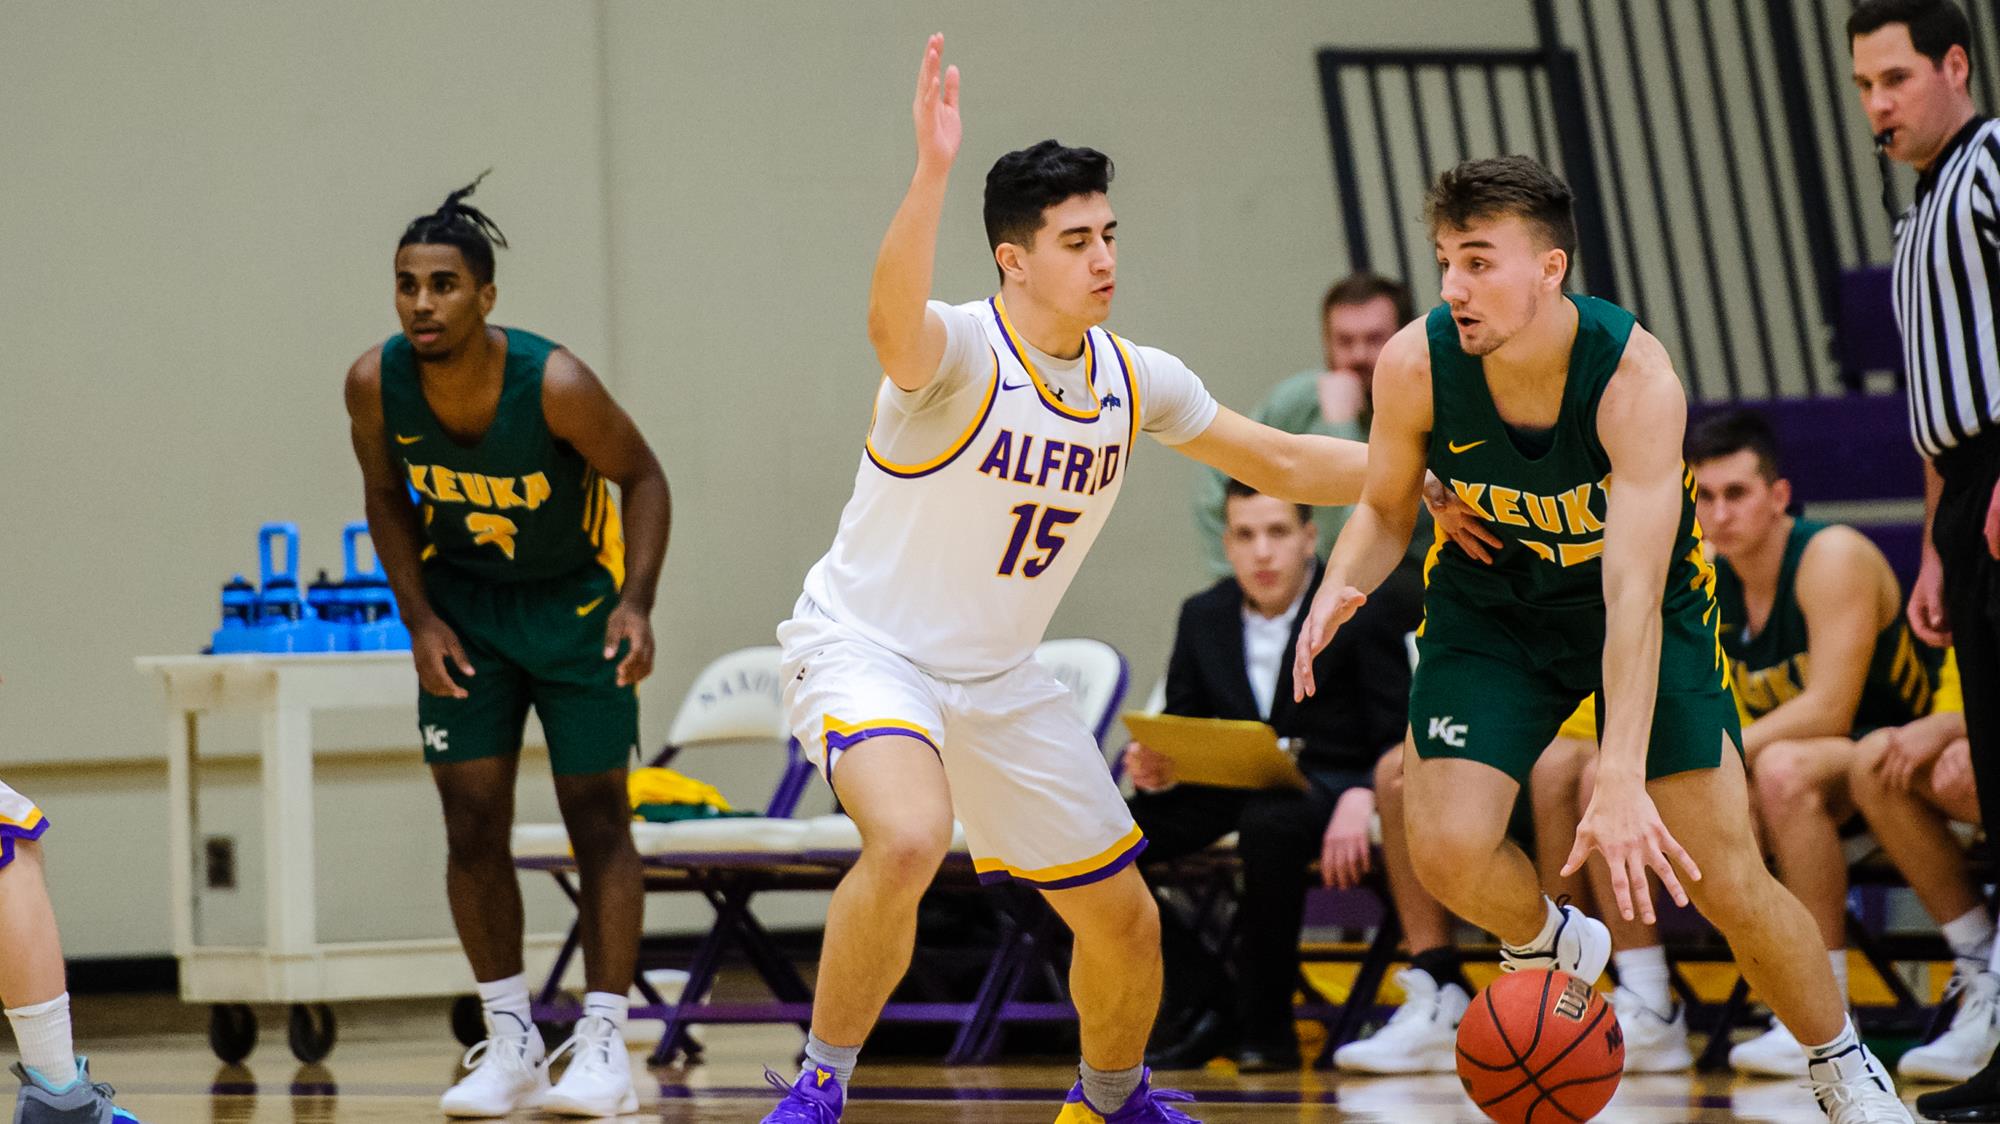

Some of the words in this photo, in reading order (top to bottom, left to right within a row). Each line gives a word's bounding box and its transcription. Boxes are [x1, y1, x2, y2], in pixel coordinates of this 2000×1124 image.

[1449, 473, 1612, 536] KEUK
[997, 500, 1084, 580] 15
[423, 724, 449, 752] KC
[1427, 715, 1469, 748] KC
